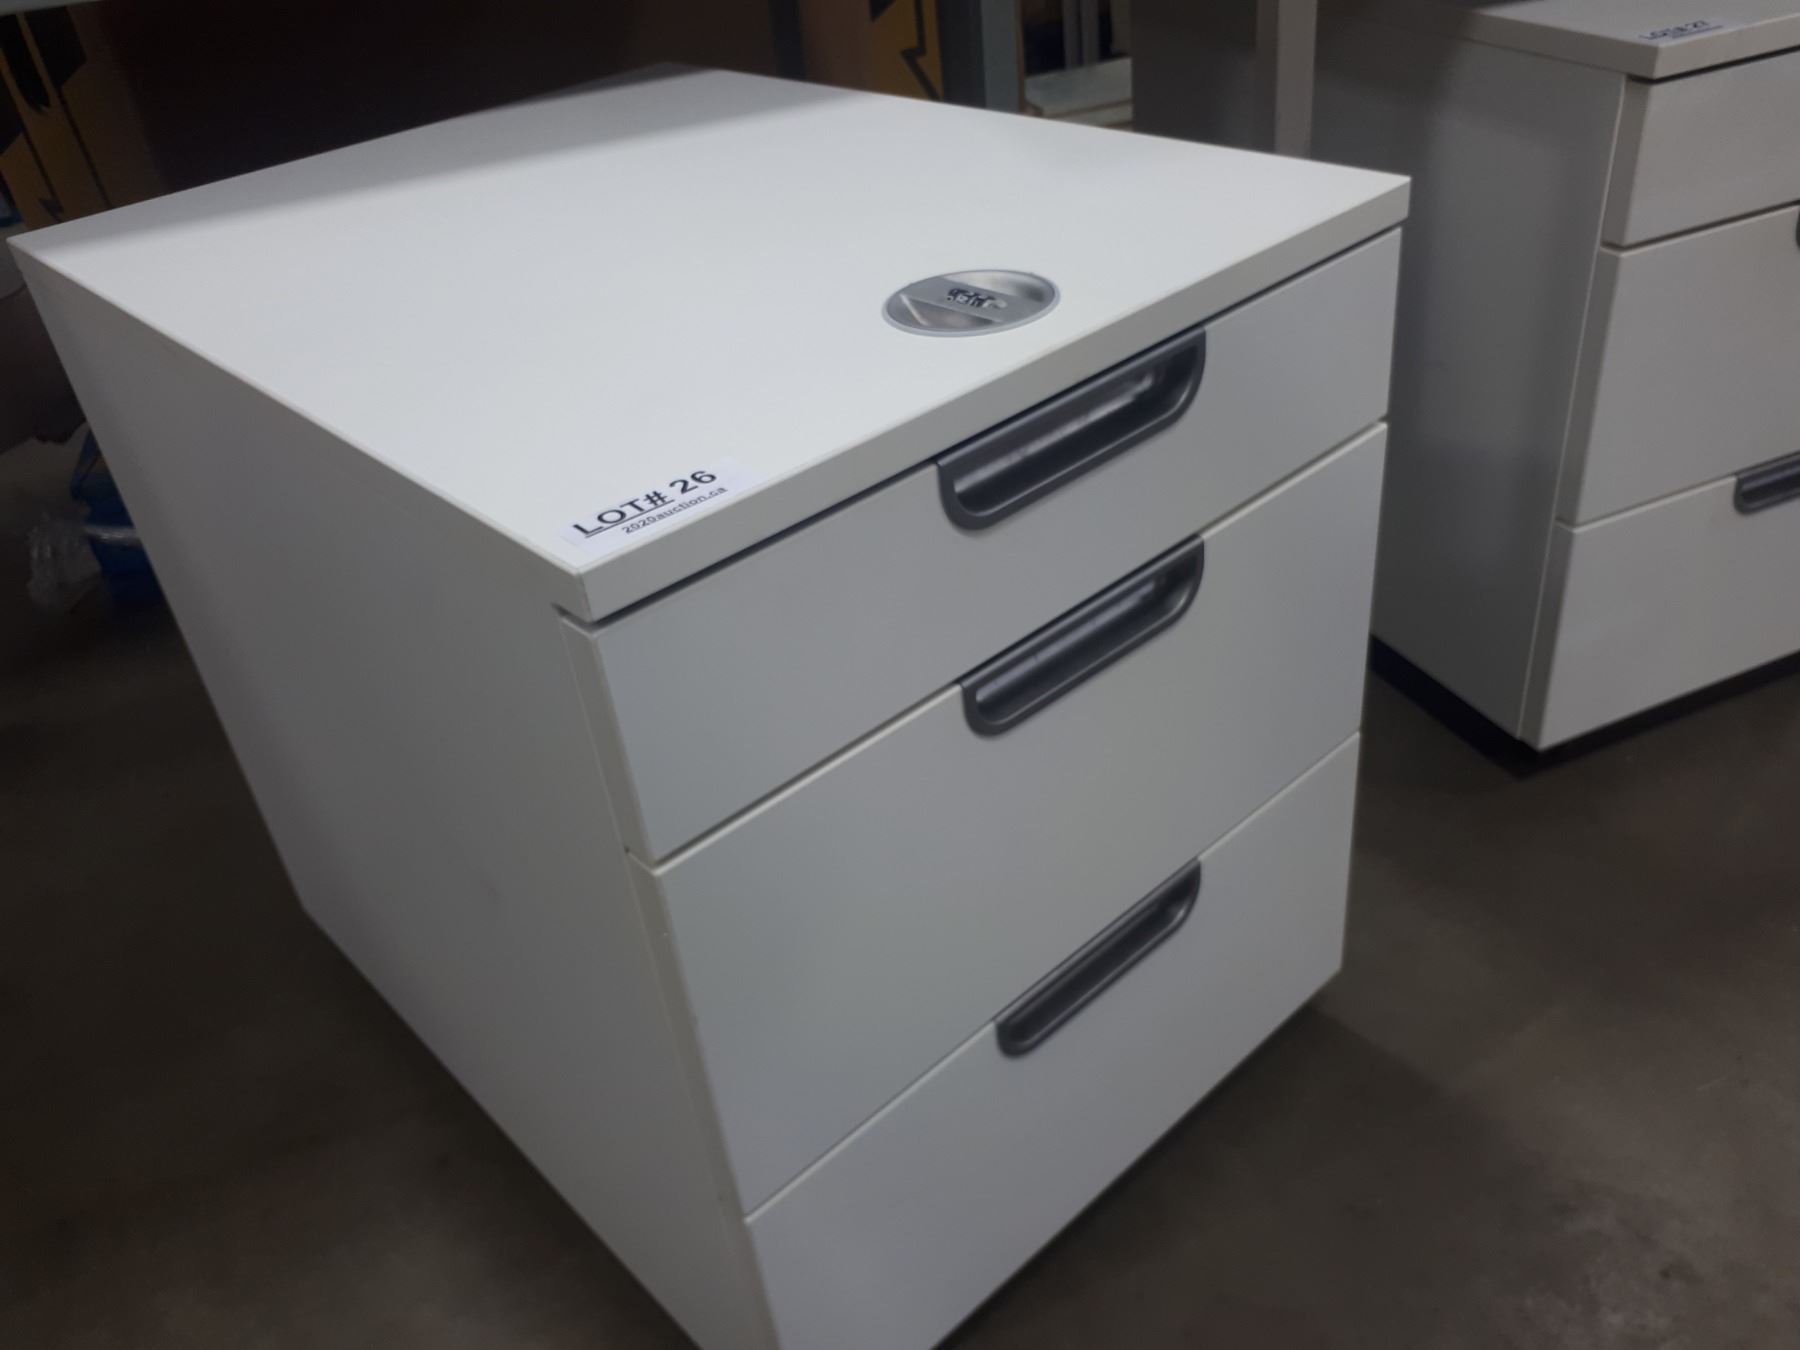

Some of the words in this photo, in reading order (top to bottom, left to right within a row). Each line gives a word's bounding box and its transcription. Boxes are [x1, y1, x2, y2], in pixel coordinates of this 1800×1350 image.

[573, 491, 672, 536] LOT#
[669, 471, 717, 494] 26
[622, 488, 727, 533] 2020auction.ca
